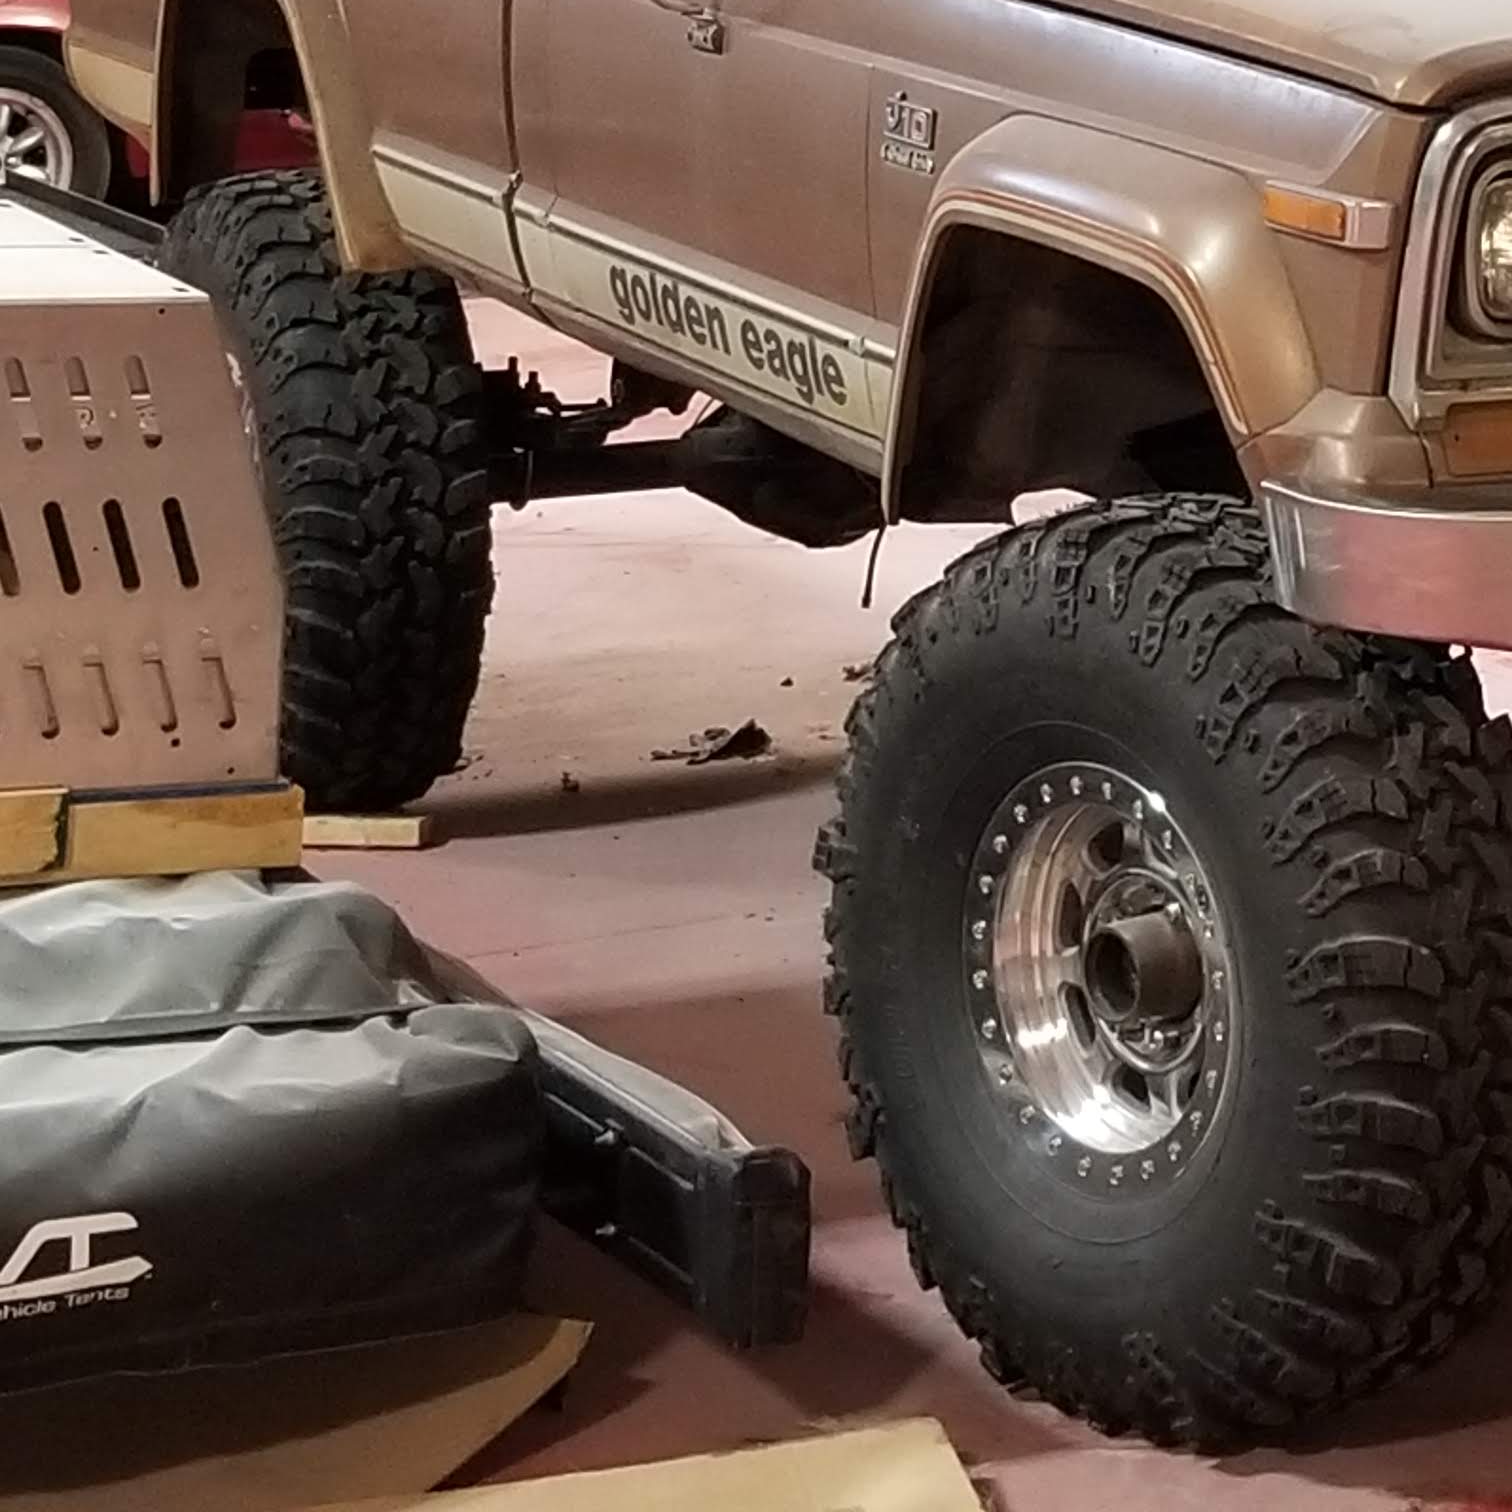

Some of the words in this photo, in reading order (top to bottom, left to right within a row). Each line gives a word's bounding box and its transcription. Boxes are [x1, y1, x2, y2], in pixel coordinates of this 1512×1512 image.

[609, 265, 731, 356] golden
[740, 319, 847, 406] eagle
[64, 1287, 130, 1308] Tents
